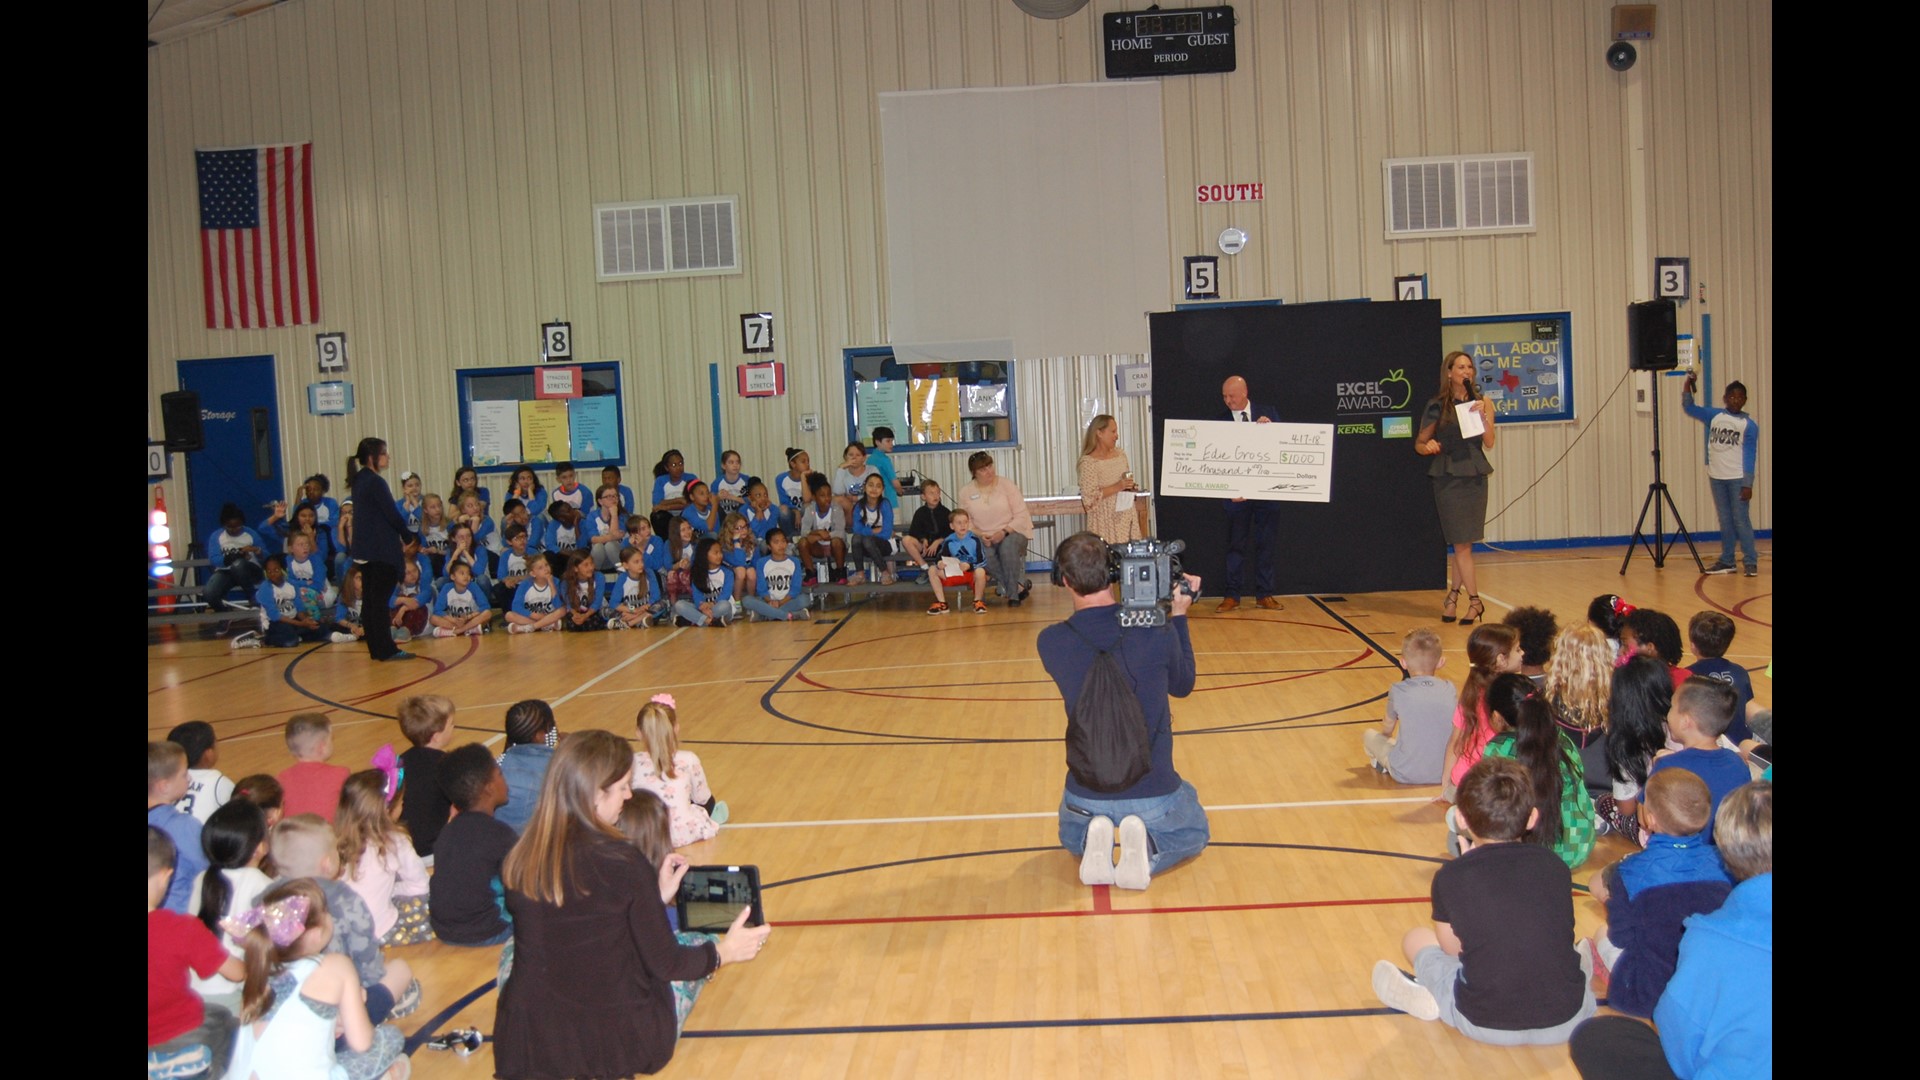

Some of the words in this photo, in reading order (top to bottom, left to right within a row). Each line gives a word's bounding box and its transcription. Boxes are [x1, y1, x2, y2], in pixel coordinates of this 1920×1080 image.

[1111, 38, 1153, 51] HOME
[1187, 33, 1229, 47] GUEST
[1154, 53, 1189, 63] PERIOD
[1197, 183, 1264, 202] SOUTH
[1195, 267, 1210, 289] 5
[1664, 270, 1679, 292] 3
[749, 323, 762, 344] 7
[552, 331, 566, 352] 8
[1474, 345, 1500, 357] ALL
[1510, 341, 1559, 355] ABOUT
[323, 341, 338, 362] 9
[1497, 356, 1522, 369] ME
[546, 382, 572, 390] STRETCH
[1336, 382, 1383, 396] EXCEL
[1336, 396, 1392, 410] AWARD
[1528, 396, 1559, 411] MAC
[201, 409, 237, 422] Storage
[1203, 443, 1231, 461] Edie
[1234, 445, 1271, 461] Gross
